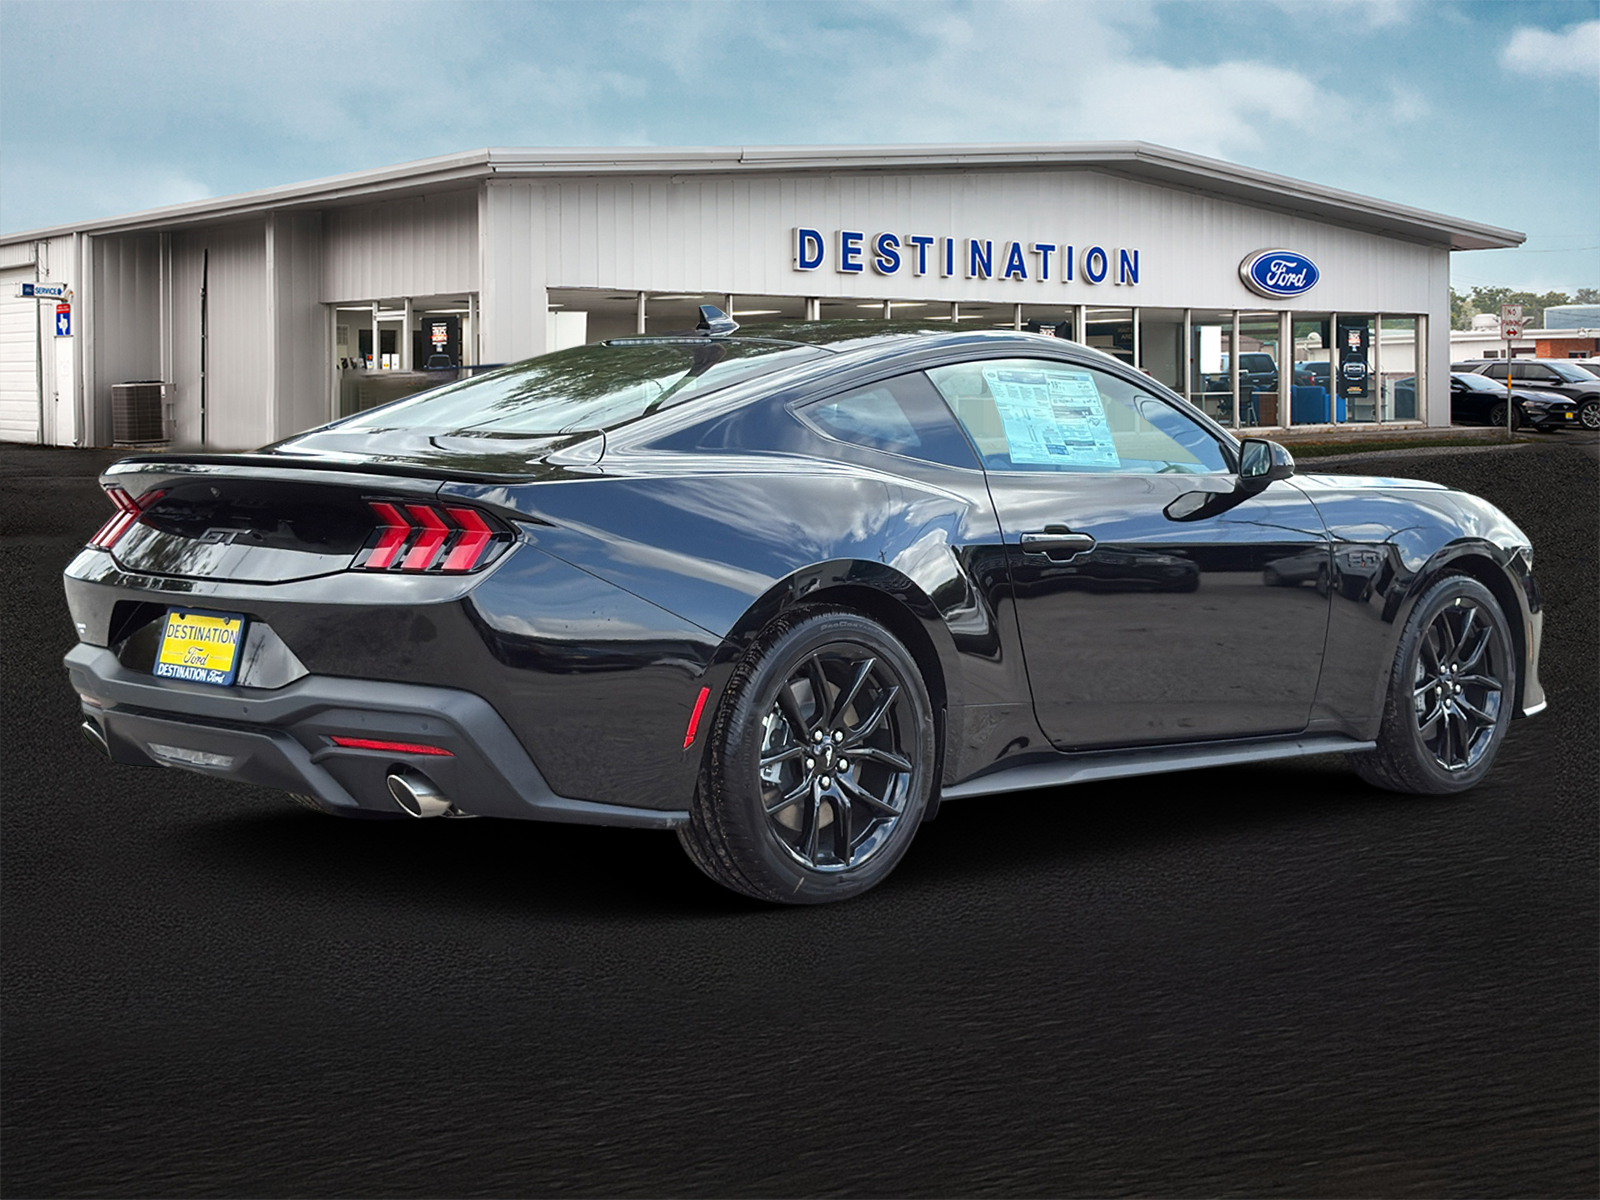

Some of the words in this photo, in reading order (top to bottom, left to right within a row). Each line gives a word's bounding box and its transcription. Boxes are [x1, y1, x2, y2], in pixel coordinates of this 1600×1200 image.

[794, 227, 1141, 287] DESTINATION
[1266, 260, 1307, 287] Ford
[35, 286, 57, 295] SERVICE
[198, 527, 252, 545] GT
[167, 624, 238, 644] DESTINATION
[183, 646, 209, 666] Ford
[158, 663, 207, 682] DESTINATION
[207, 670, 226, 683] Ford
